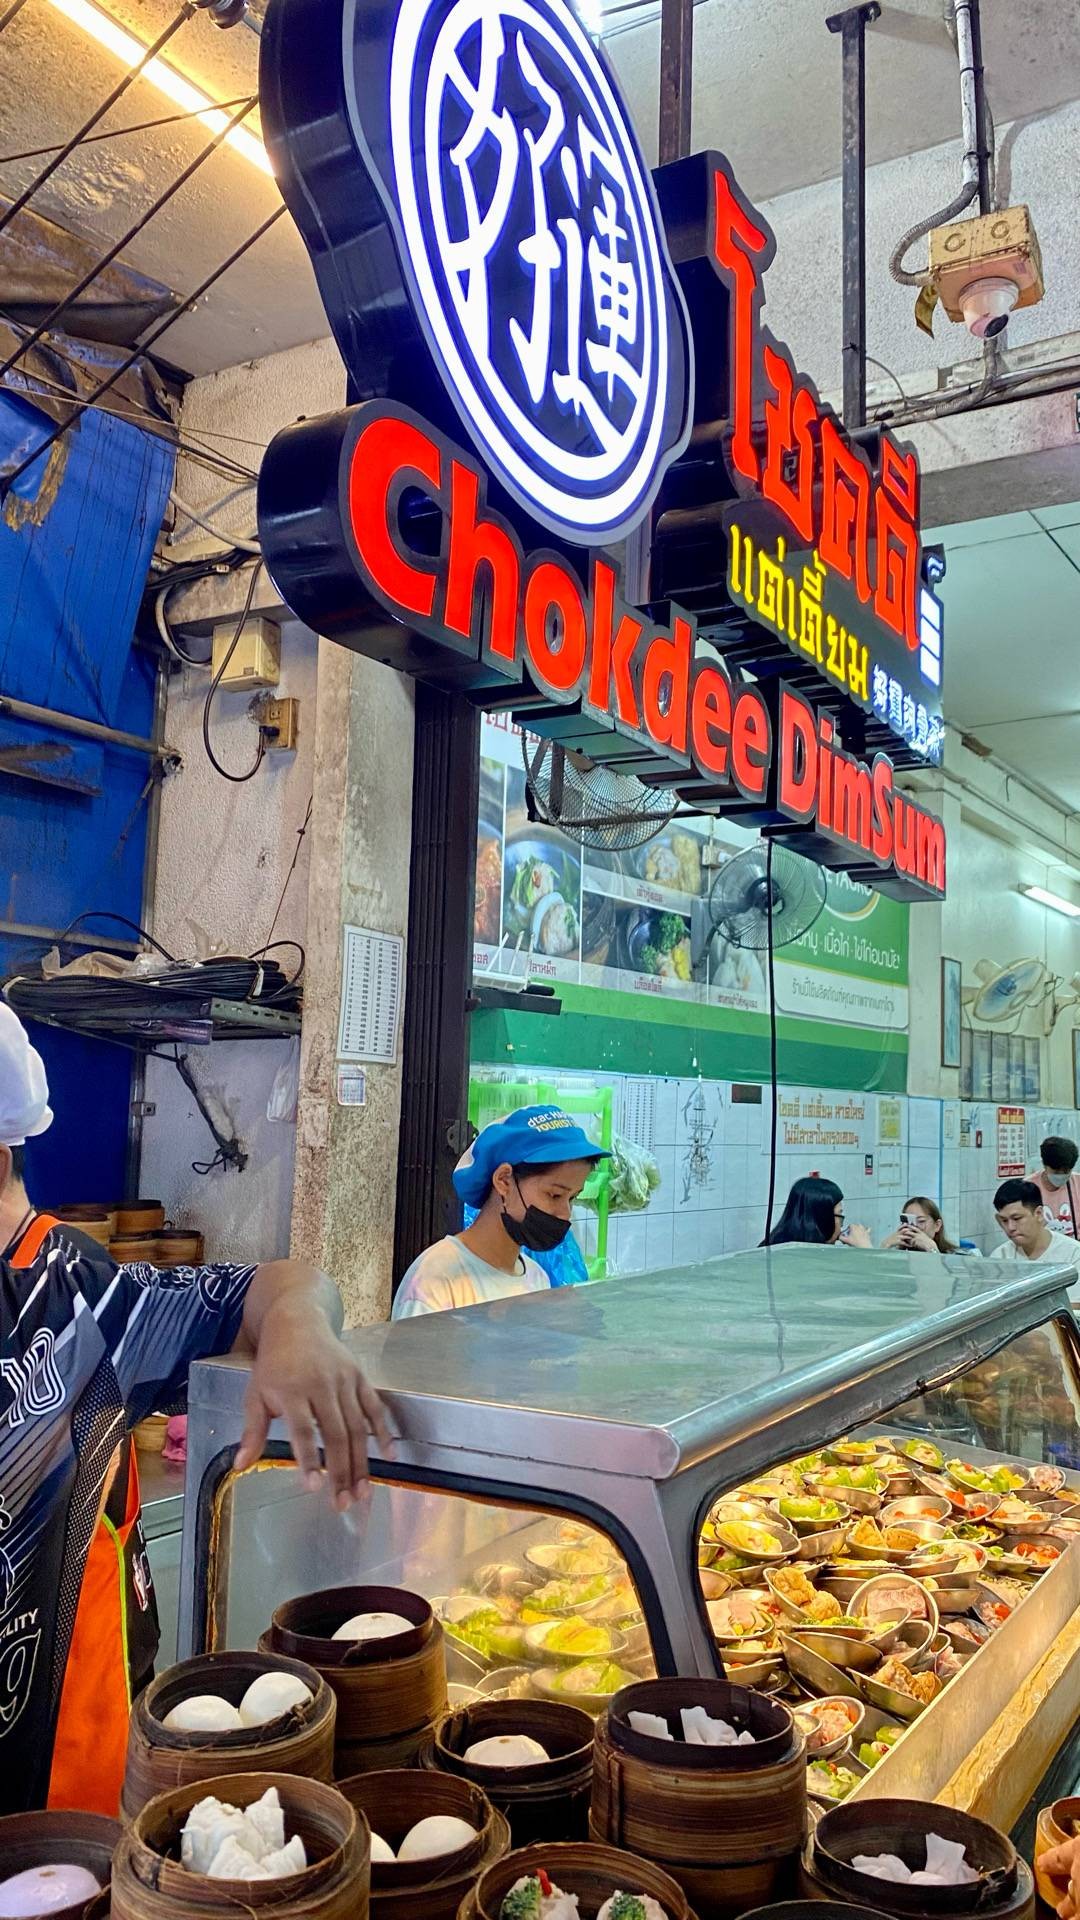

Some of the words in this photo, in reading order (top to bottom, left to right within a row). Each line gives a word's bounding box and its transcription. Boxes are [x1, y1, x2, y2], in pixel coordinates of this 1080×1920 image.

[714, 170, 918, 651] โชคดี
[349, 416, 768, 793] Chokdee
[729, 524, 869, 701] แต่เตี้ยม
[527, 1112, 552, 1128] dtac
